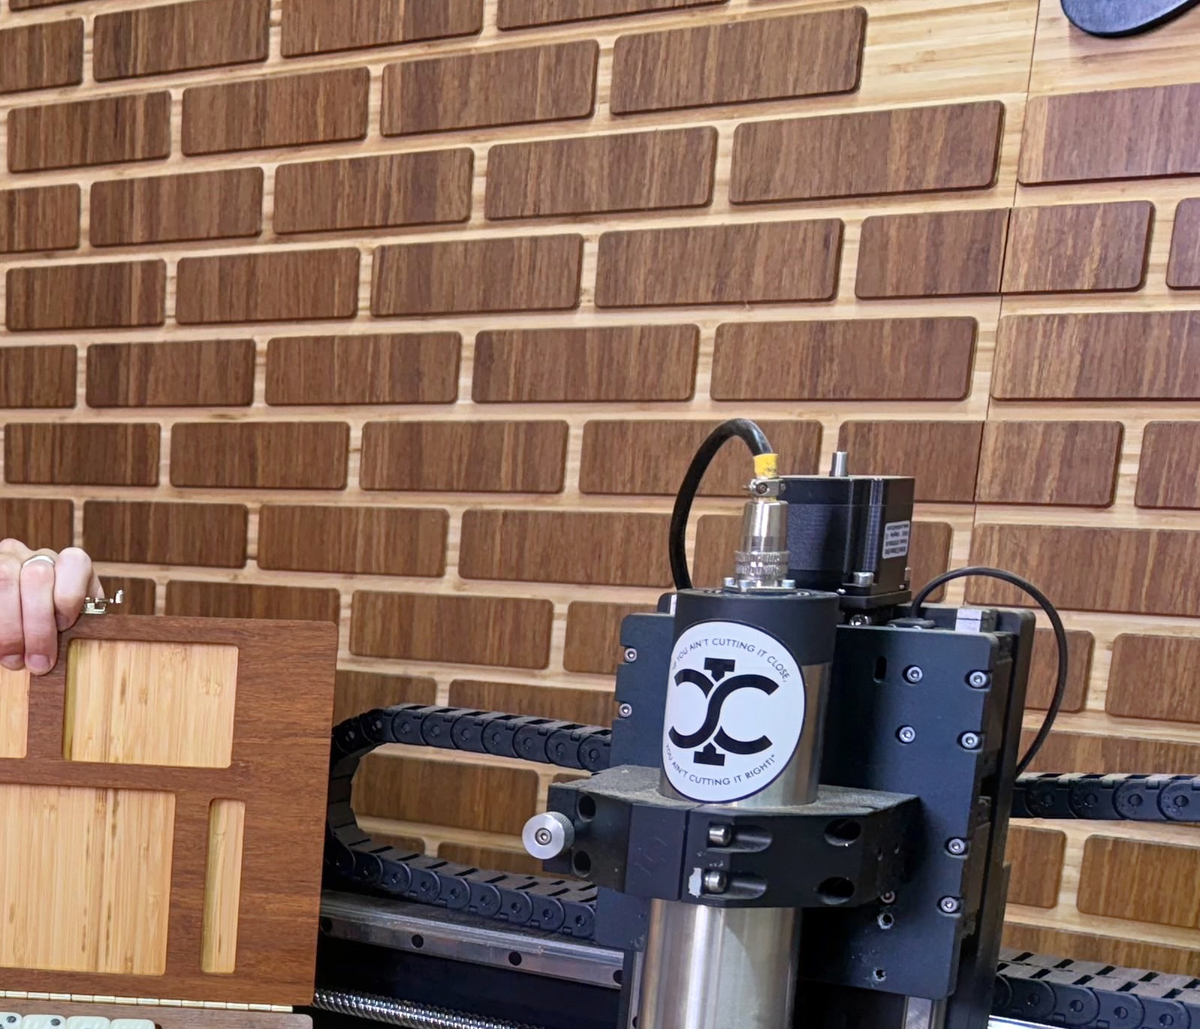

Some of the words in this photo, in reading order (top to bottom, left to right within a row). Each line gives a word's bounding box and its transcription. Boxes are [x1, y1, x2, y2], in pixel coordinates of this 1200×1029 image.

[689, 638, 709, 651] AIN'T
[711, 637, 756, 653] CUTTING
[756, 648, 768, 657] IT
[672, 761, 688, 778] AIN'T
[689, 774, 731, 786] CUTTING
[733, 774, 742, 784] IT
